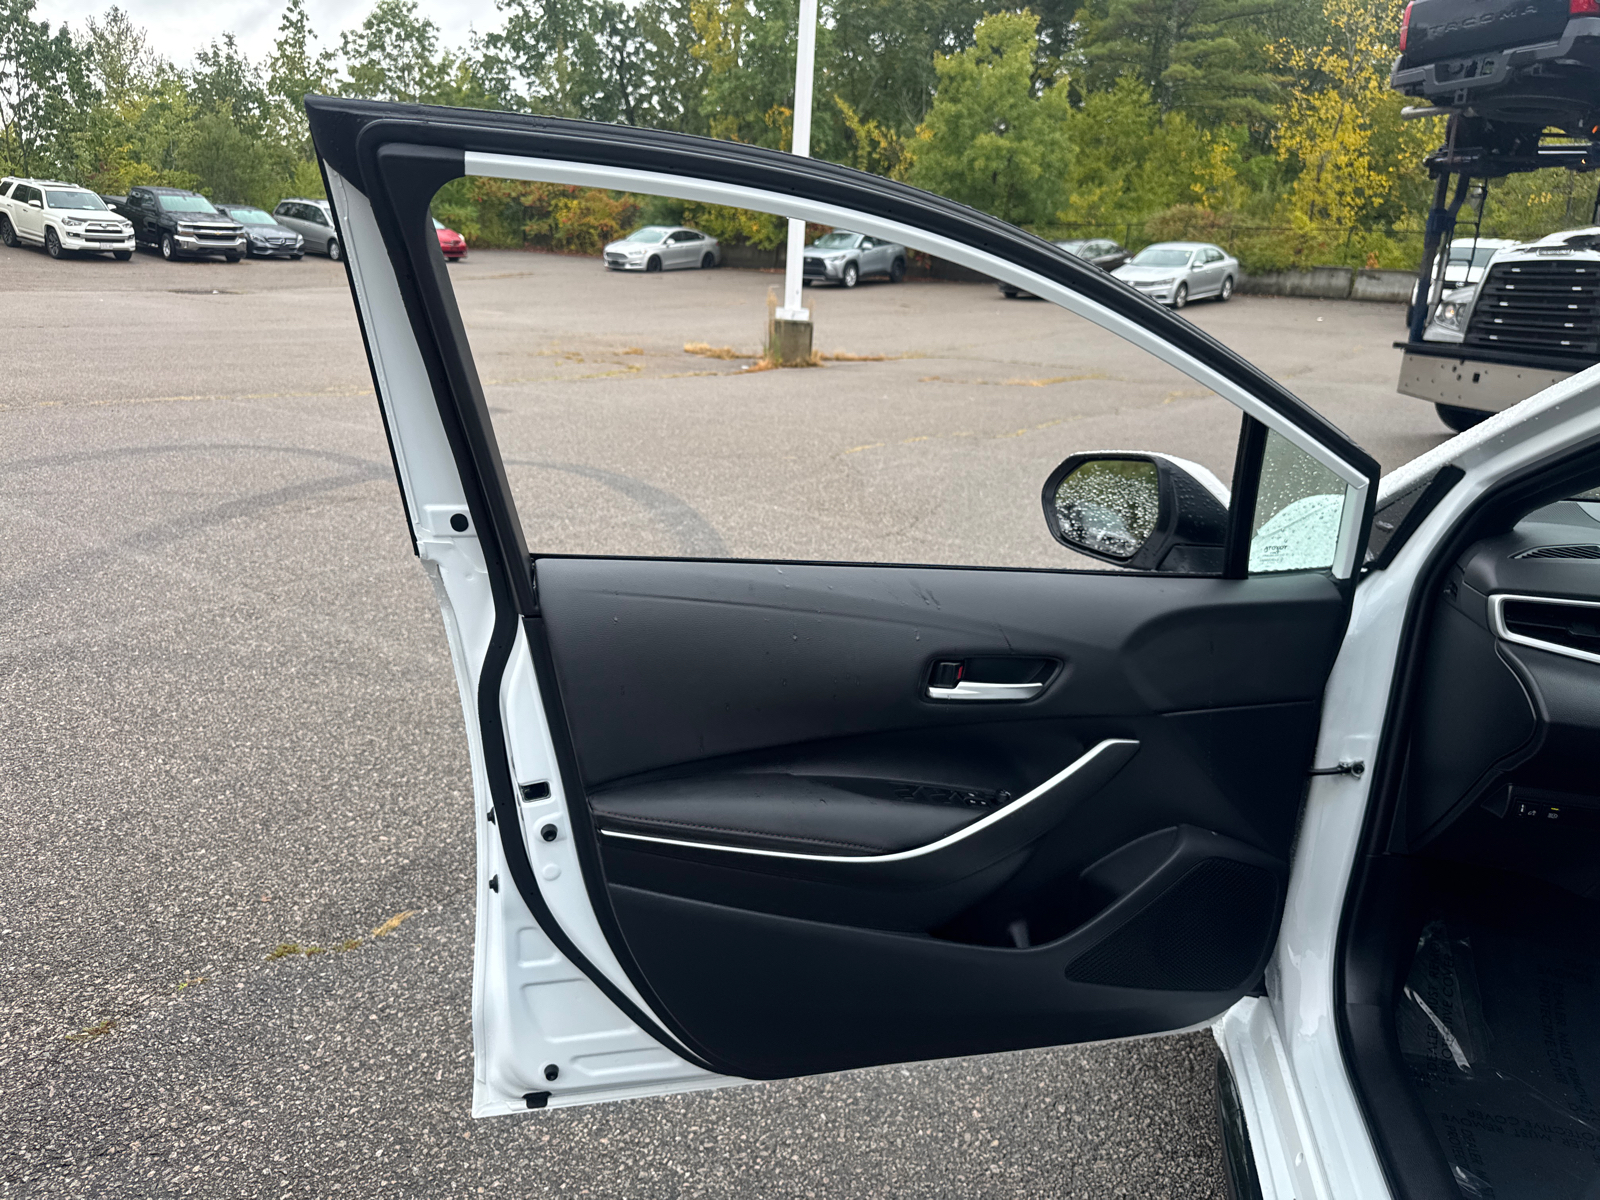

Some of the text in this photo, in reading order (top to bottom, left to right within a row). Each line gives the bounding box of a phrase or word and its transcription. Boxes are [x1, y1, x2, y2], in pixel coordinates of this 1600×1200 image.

[1428, 5, 1538, 36] TACOMA
[1442, 953, 1455, 1074] PROTTIVE COVER
[1427, 1024, 1438, 1071] DEALER
[1547, 1049, 1568, 1085] COVER
[1440, 1112, 1505, 1134] REMOVE
[1466, 1109, 1520, 1126] COVER
[1514, 1128, 1552, 1143] MUST
